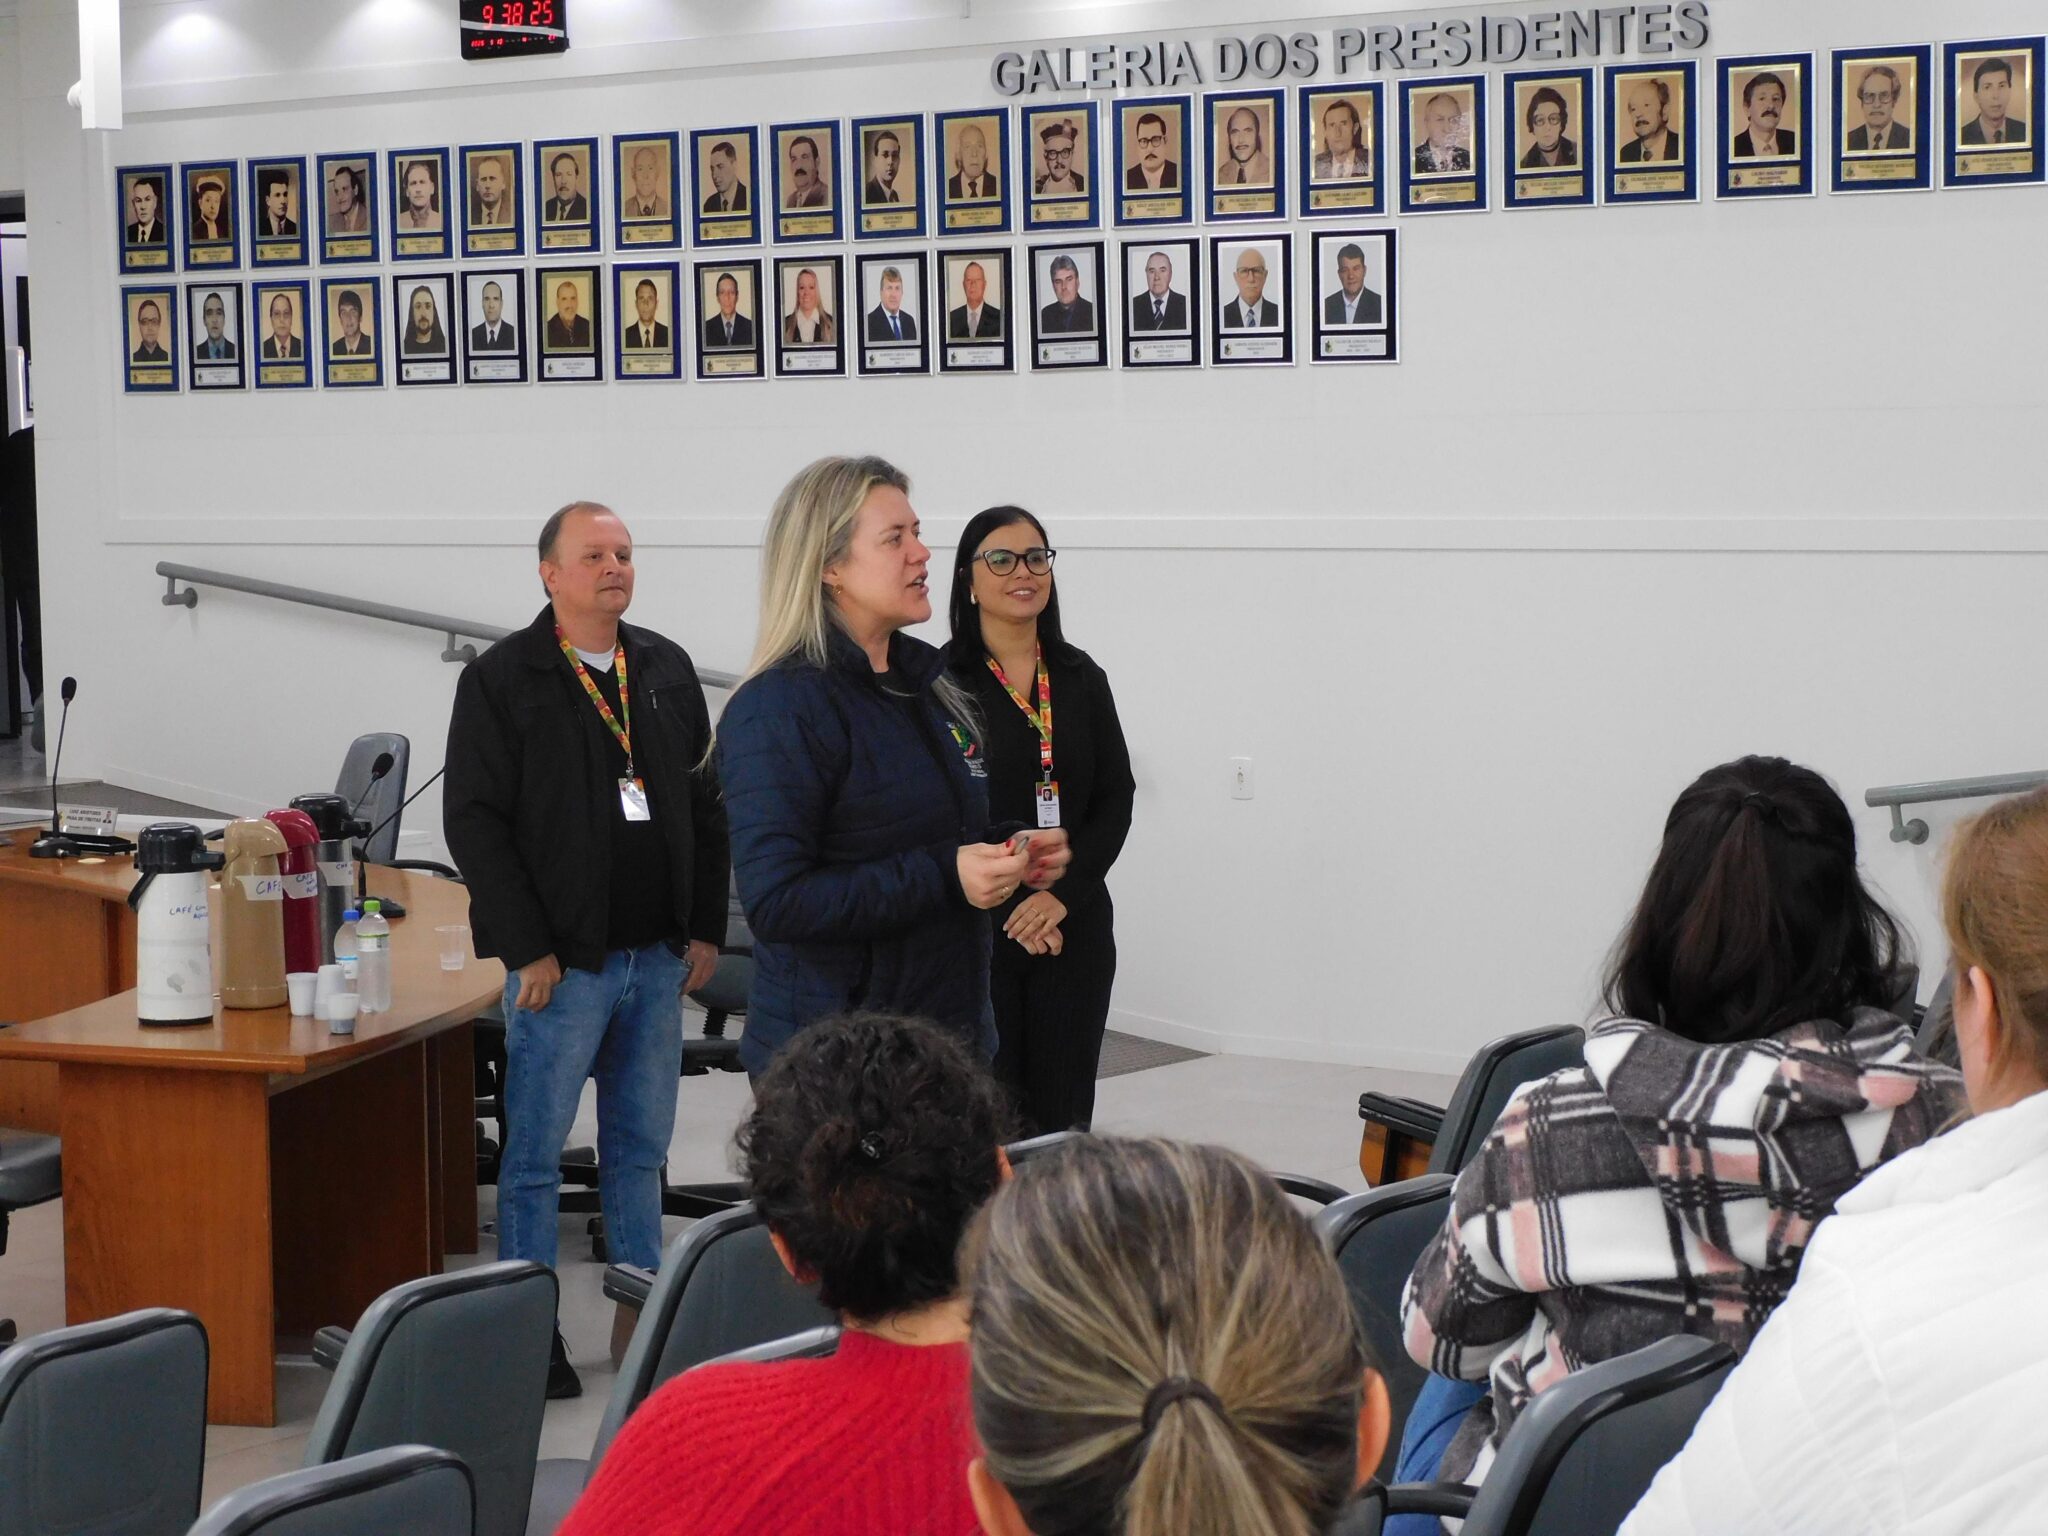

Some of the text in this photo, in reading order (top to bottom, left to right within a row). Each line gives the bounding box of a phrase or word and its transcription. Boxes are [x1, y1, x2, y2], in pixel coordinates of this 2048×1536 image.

[989, 0, 1709, 97] GALERIA DOS PRESIDENTES
